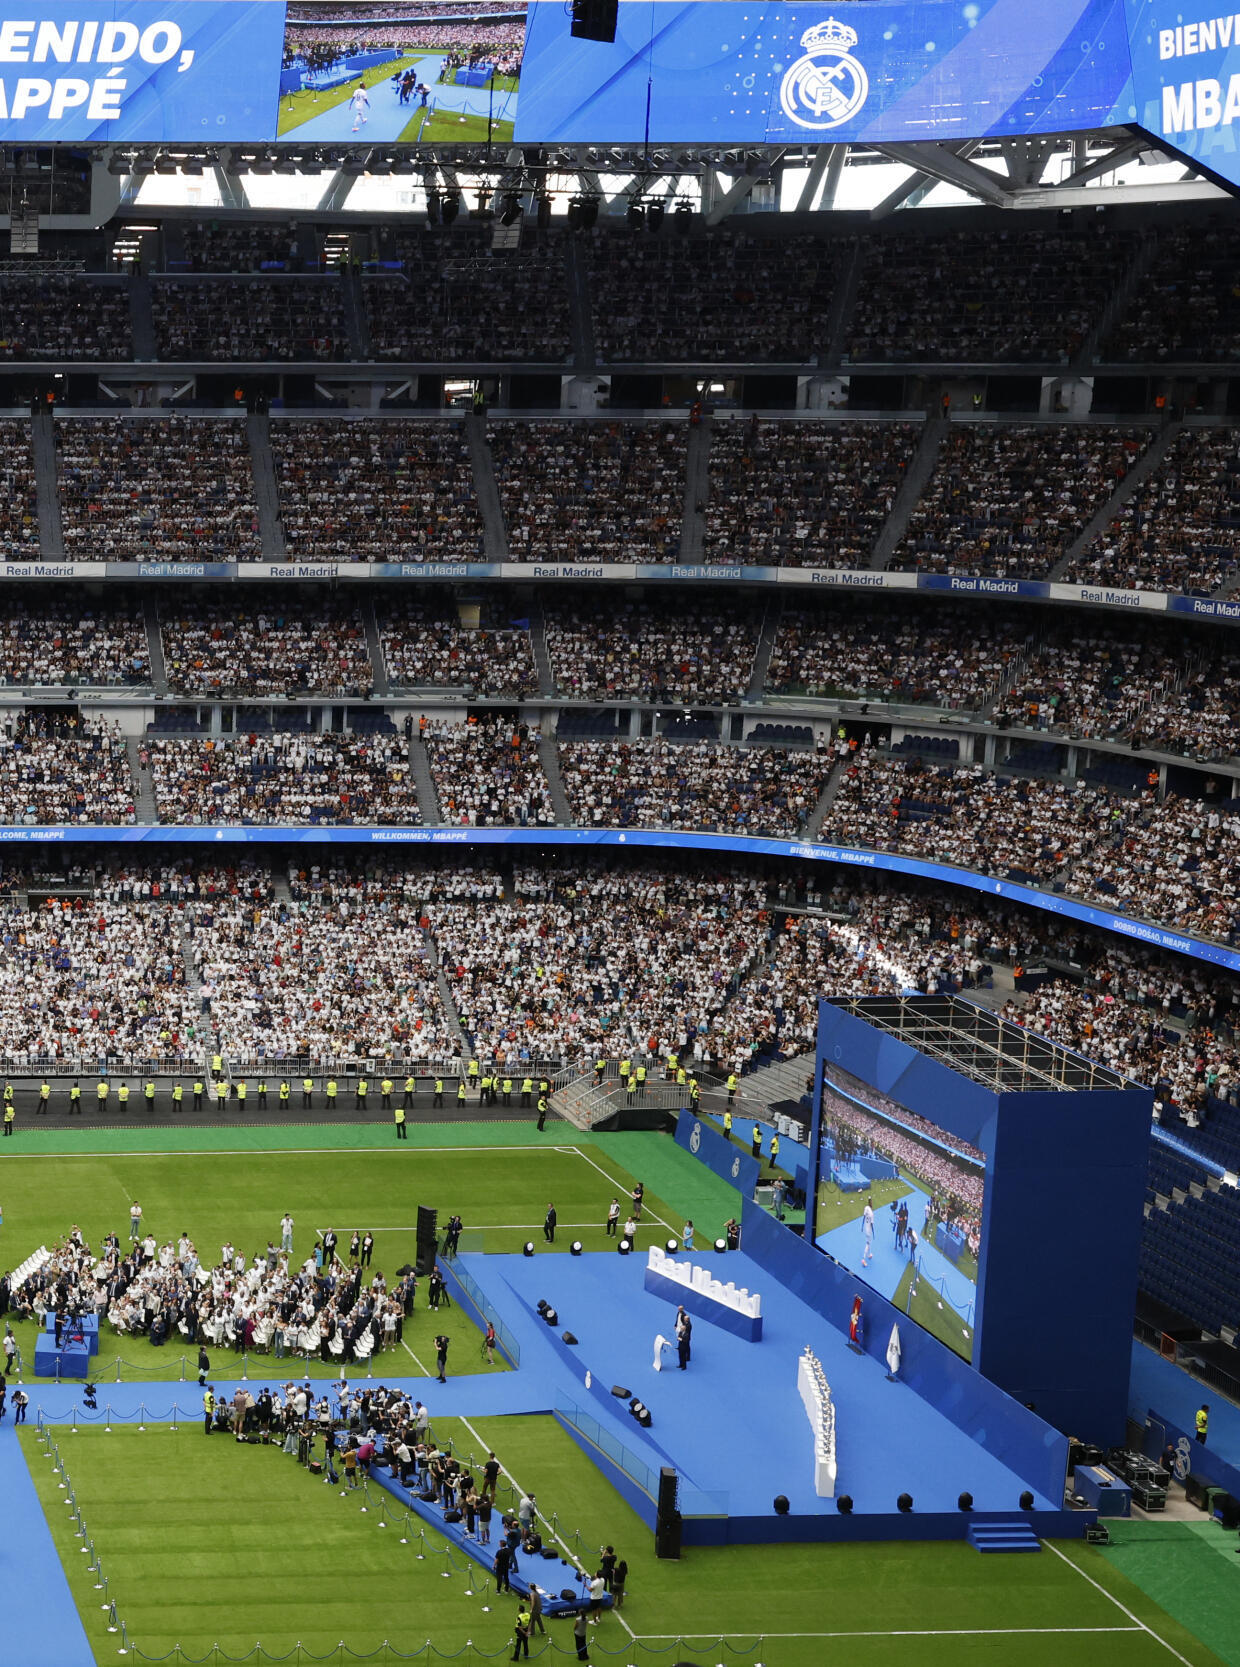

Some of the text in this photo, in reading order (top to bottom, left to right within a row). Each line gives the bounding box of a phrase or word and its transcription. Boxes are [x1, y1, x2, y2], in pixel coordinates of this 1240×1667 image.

[6, 566, 74, 576] Real Madrid
[140, 564, 204, 574] Real Madrid
[270, 566, 338, 576] Real Madrid
[402, 565, 467, 576] Real Madrid
[534, 567, 603, 578] Real Madrid
[672, 566, 741, 578] Real Madrid
[812, 572, 883, 586] Real Madrid
[951, 578, 1018, 592] Real Madrid
[1081, 590, 1140, 606] Real Madrid
[1194, 600, 1215, 614] Real
[30, 830, 65, 838] MBAPPÉ
[372, 832, 468, 840] WILLKOMMEN, MBAPPÉ
[790, 846, 875, 865] BIENVENUE, MBAPPÉ
[1162, 936, 1191, 952] MBAPPÉ
